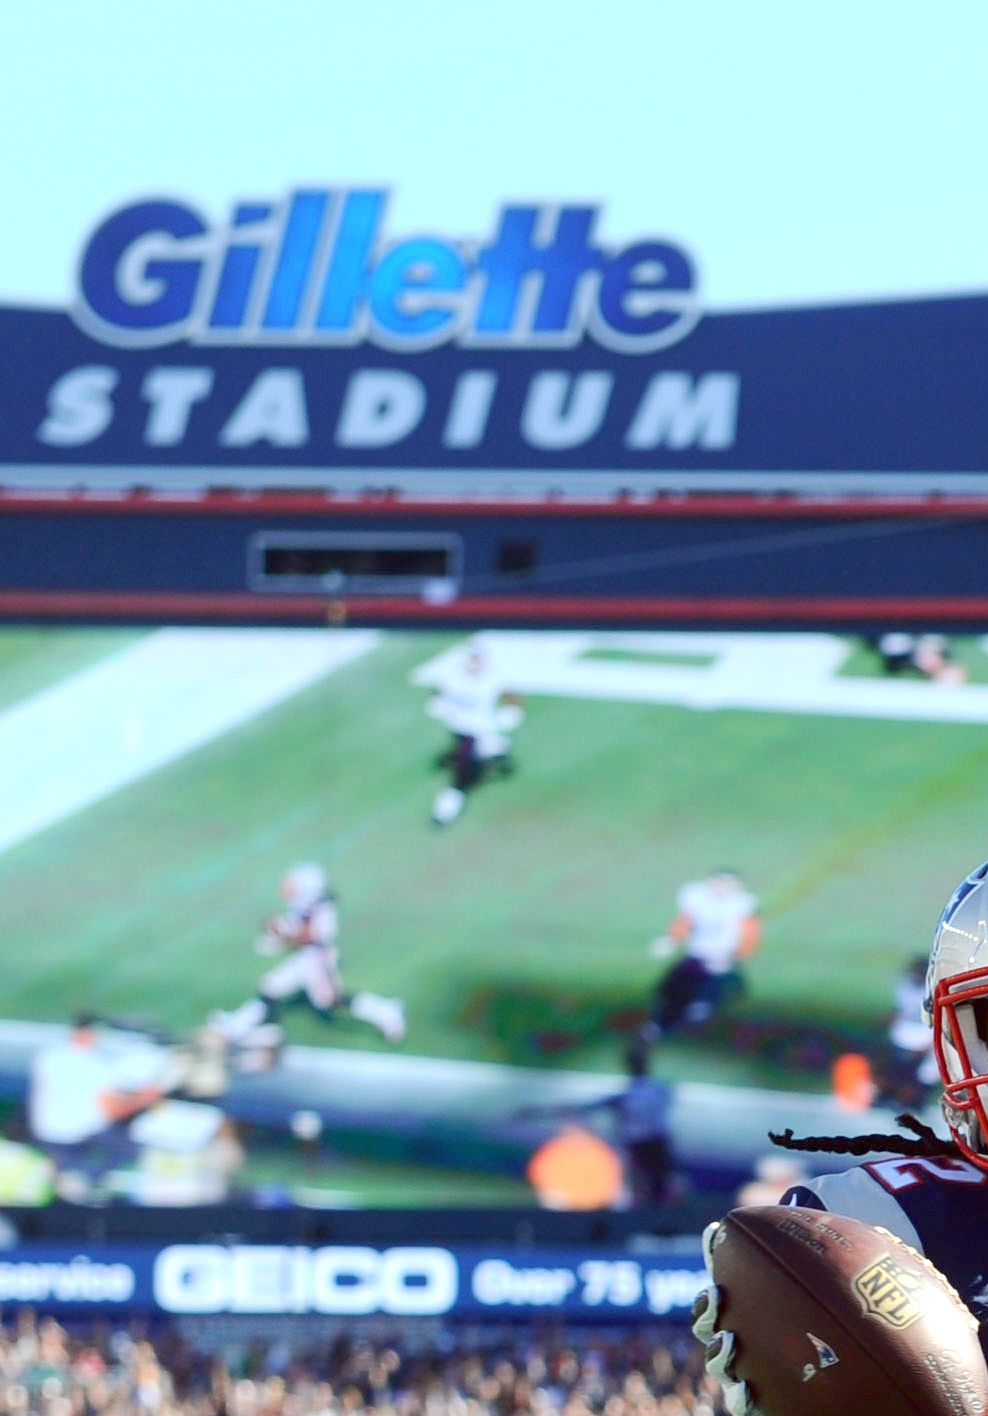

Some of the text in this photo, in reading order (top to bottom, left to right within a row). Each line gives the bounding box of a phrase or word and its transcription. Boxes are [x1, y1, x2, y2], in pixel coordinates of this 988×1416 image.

[74, 187, 698, 348] Gillette
[36, 364, 742, 452] STADIUM
[153, 1244, 459, 1316] GEICO
[472, 1259, 576, 1306] Over
[577, 1260, 642, 1307] 75
[861, 1270, 911, 1323] NFL
